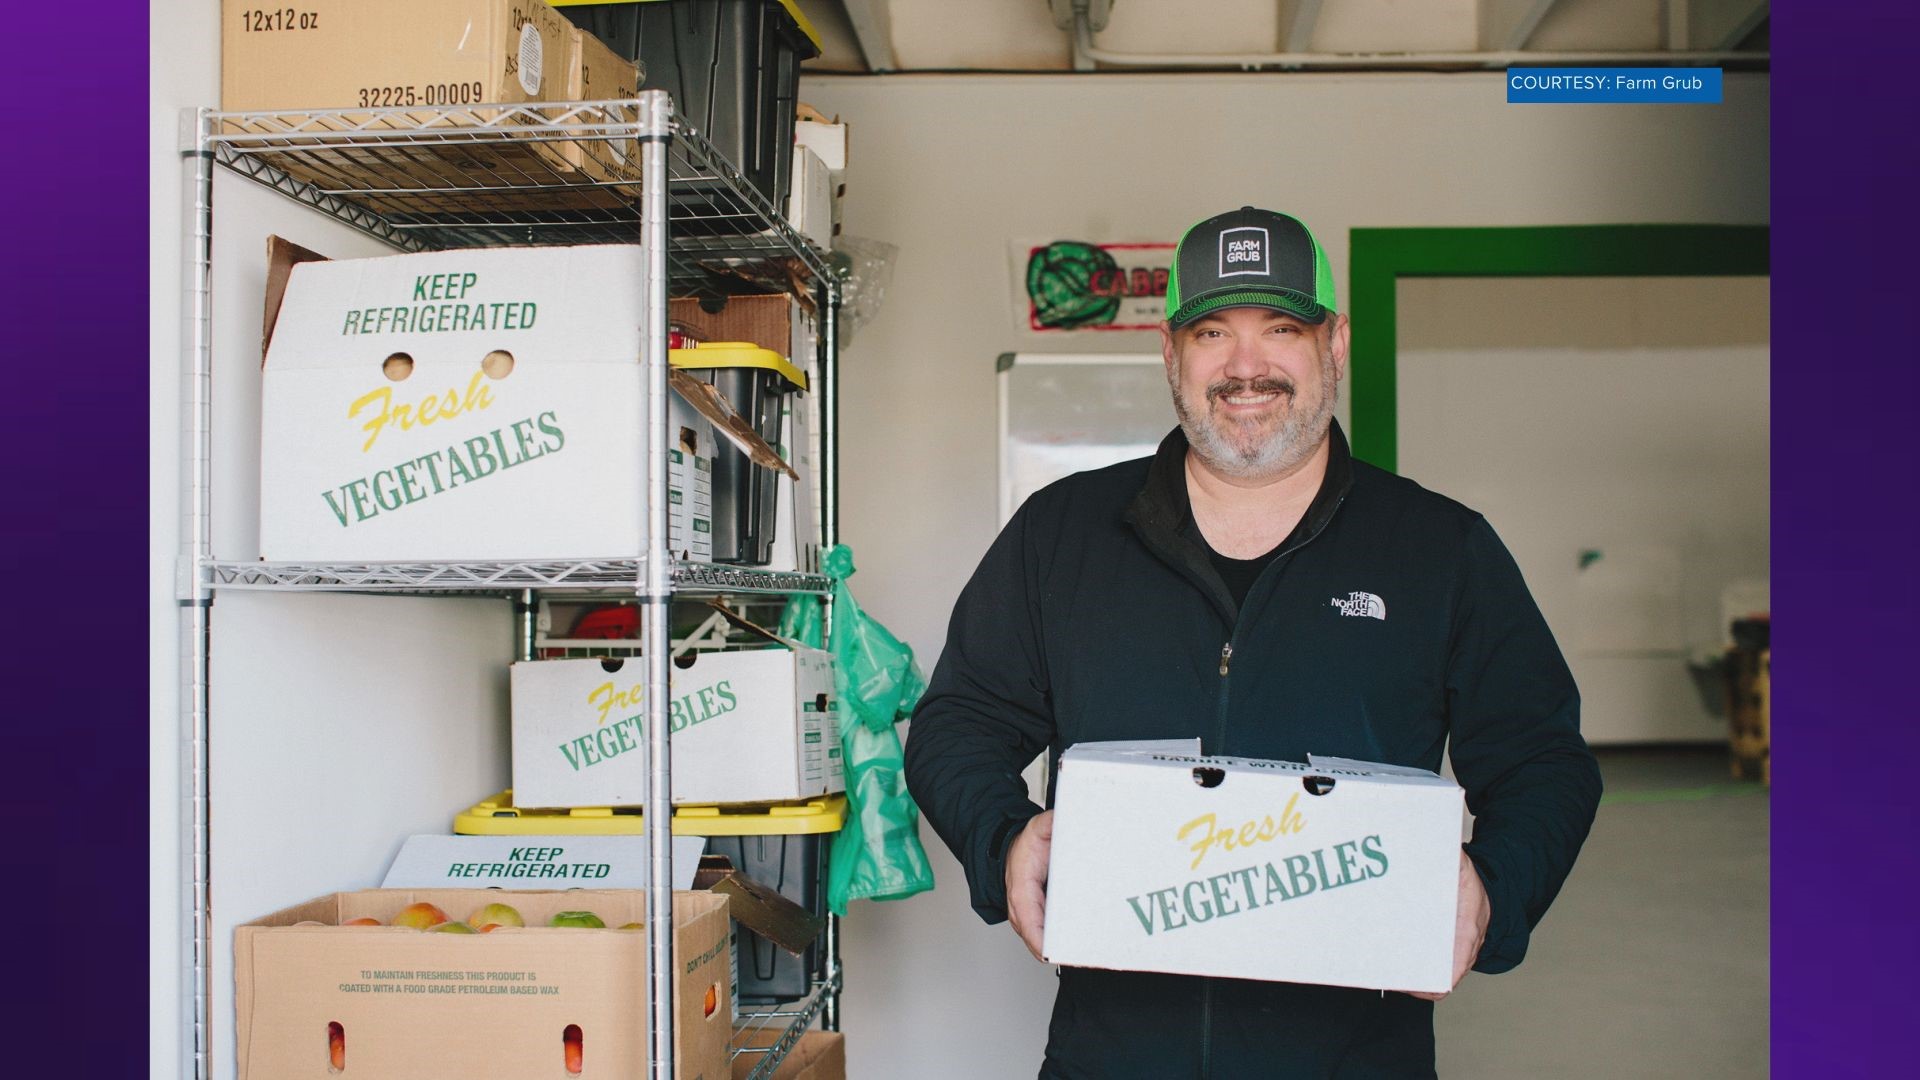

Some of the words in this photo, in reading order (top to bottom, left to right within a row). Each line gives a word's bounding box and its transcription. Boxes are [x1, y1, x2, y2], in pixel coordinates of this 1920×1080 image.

[243, 8, 295, 32] 12x12
[300, 12, 318, 30] oz
[359, 81, 483, 108] 32225-00009
[1228, 240, 1260, 252] FARM
[1226, 251, 1261, 263] GRUB
[413, 272, 478, 301] KEEP
[342, 302, 538, 335] REFRIGERATED
[347, 369, 496, 453] Fresh
[321, 410, 566, 528] VEGETABLES
[1331, 597, 1368, 609] NORTH
[1348, 591, 1369, 601] THE
[1340, 607, 1368, 617] FACE
[558, 680, 737, 771] VEGETBLES
[1176, 792, 1308, 870] Fresh
[509, 847, 564, 862] KEEP
[447, 863, 611, 879] REFRIGERATED
[1126, 834, 1389, 936] VEGETABLES
[361, 970, 372, 980] TO
[373, 970, 414, 980] MAINTAIN
[416, 971, 464, 981] FRESHNESS
[465, 971, 485, 981] THIS
[486, 972, 526, 982] PRODUCT
[528, 972, 537, 982] IS
[339, 983, 371, 993] COATED
[373, 983, 394, 993] WITH
[395, 984, 401, 994] A
[404, 984, 426, 994] FOOD
[428, 984, 456, 994] GRADE
[458, 985, 508, 995] PETROLEUM
[510, 985, 538, 996] BASED
[540, 985, 560, 996] WAX
